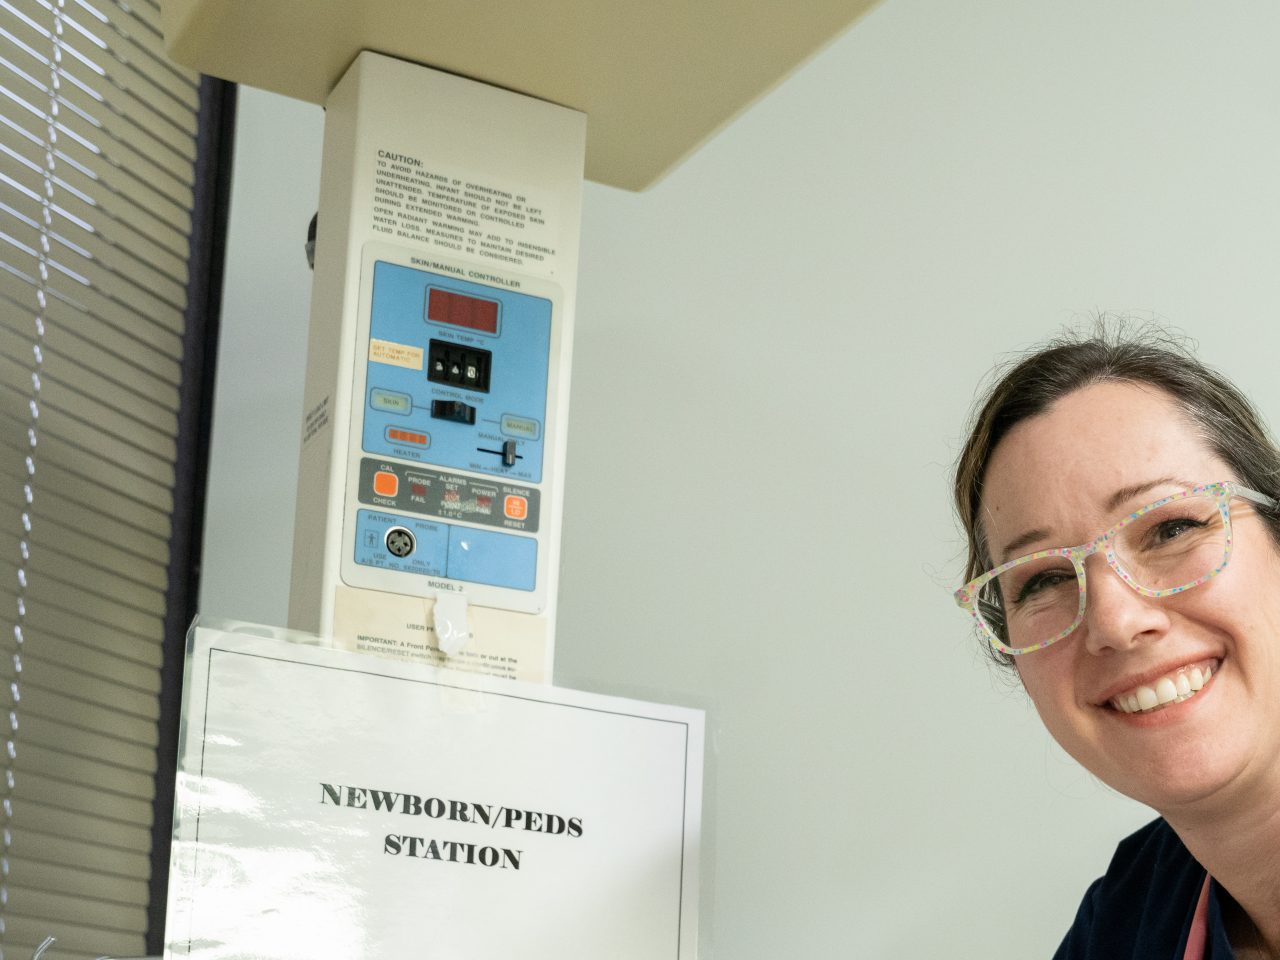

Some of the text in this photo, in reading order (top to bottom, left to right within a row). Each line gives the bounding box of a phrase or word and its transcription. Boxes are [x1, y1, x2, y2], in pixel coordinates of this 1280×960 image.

[377, 160, 386, 168] TO
[391, 164, 412, 174] AVOID
[466, 183, 512, 199] OVERHEATING
[436, 184, 460, 194] INFANT
[464, 191, 492, 203] SHOULD
[375, 196, 401, 208] DURING
[406, 204, 442, 218] EXTENDED
[376, 187, 404, 199] SHOULD
[422, 198, 462, 214] MONITORED
[480, 213, 525, 229] CONTROLLED
[428, 191, 477, 208] TEMPERATURE
[494, 207, 526, 221] EXPOSED
[374, 206, 394, 216] OPEN
[398, 212, 428, 224] RADIANT
[432, 221, 465, 233] WARMING
[469, 229, 482, 237] MAY
[373, 224, 393, 234] FLUID
[397, 230, 430, 243] BALANCE
[374, 215, 397, 226] WATER
[426, 228, 463, 242] MEASURES
[480, 241, 512, 253] MAINTAIN
[410, 257, 520, 288] SKIN/MANUAL CONTROLLER
[394, 448, 420, 458] HEATER
[380, 464, 394, 473] CAL
[408, 476, 431, 487] PROBE
[440, 475, 467, 486] ALARMS
[472, 488, 496, 497] POWER
[503, 486, 530, 497] SILENCE
[373, 497, 397, 507] CHECK
[428, 580, 456, 591] MODEL
[319, 782, 584, 838] NEWBORN/PEDS
[384, 833, 524, 870] STATION
